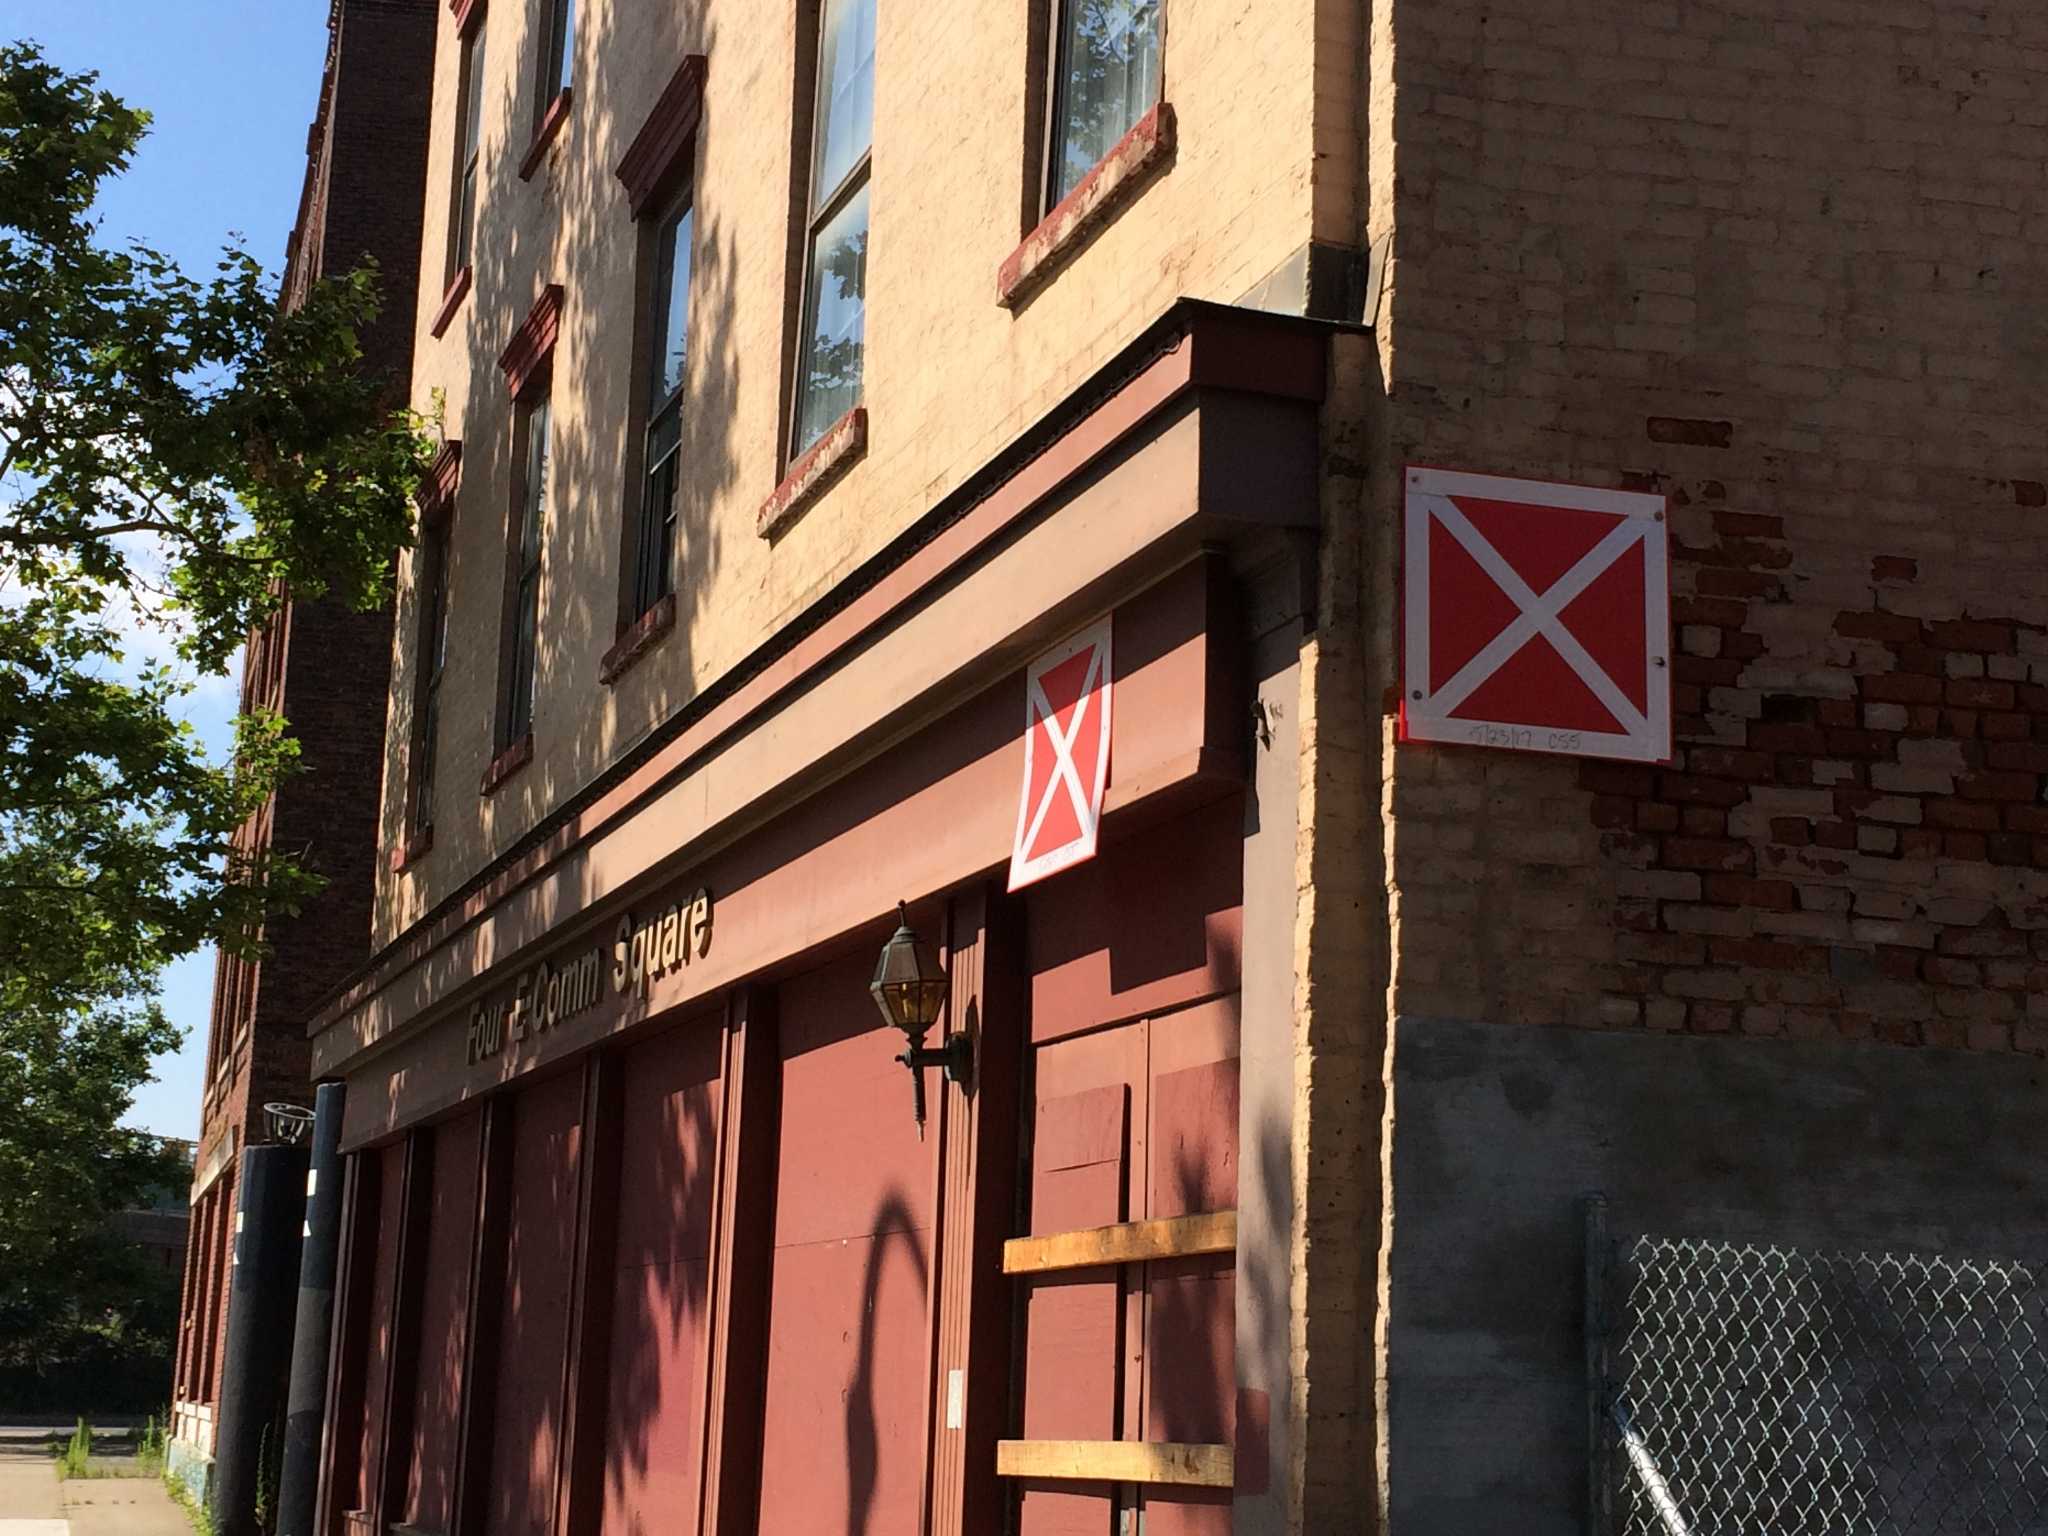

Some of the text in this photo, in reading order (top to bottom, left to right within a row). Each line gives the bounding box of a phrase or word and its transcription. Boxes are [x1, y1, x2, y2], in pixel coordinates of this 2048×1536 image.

[466, 887, 713, 1067] Four E-Comm Square
